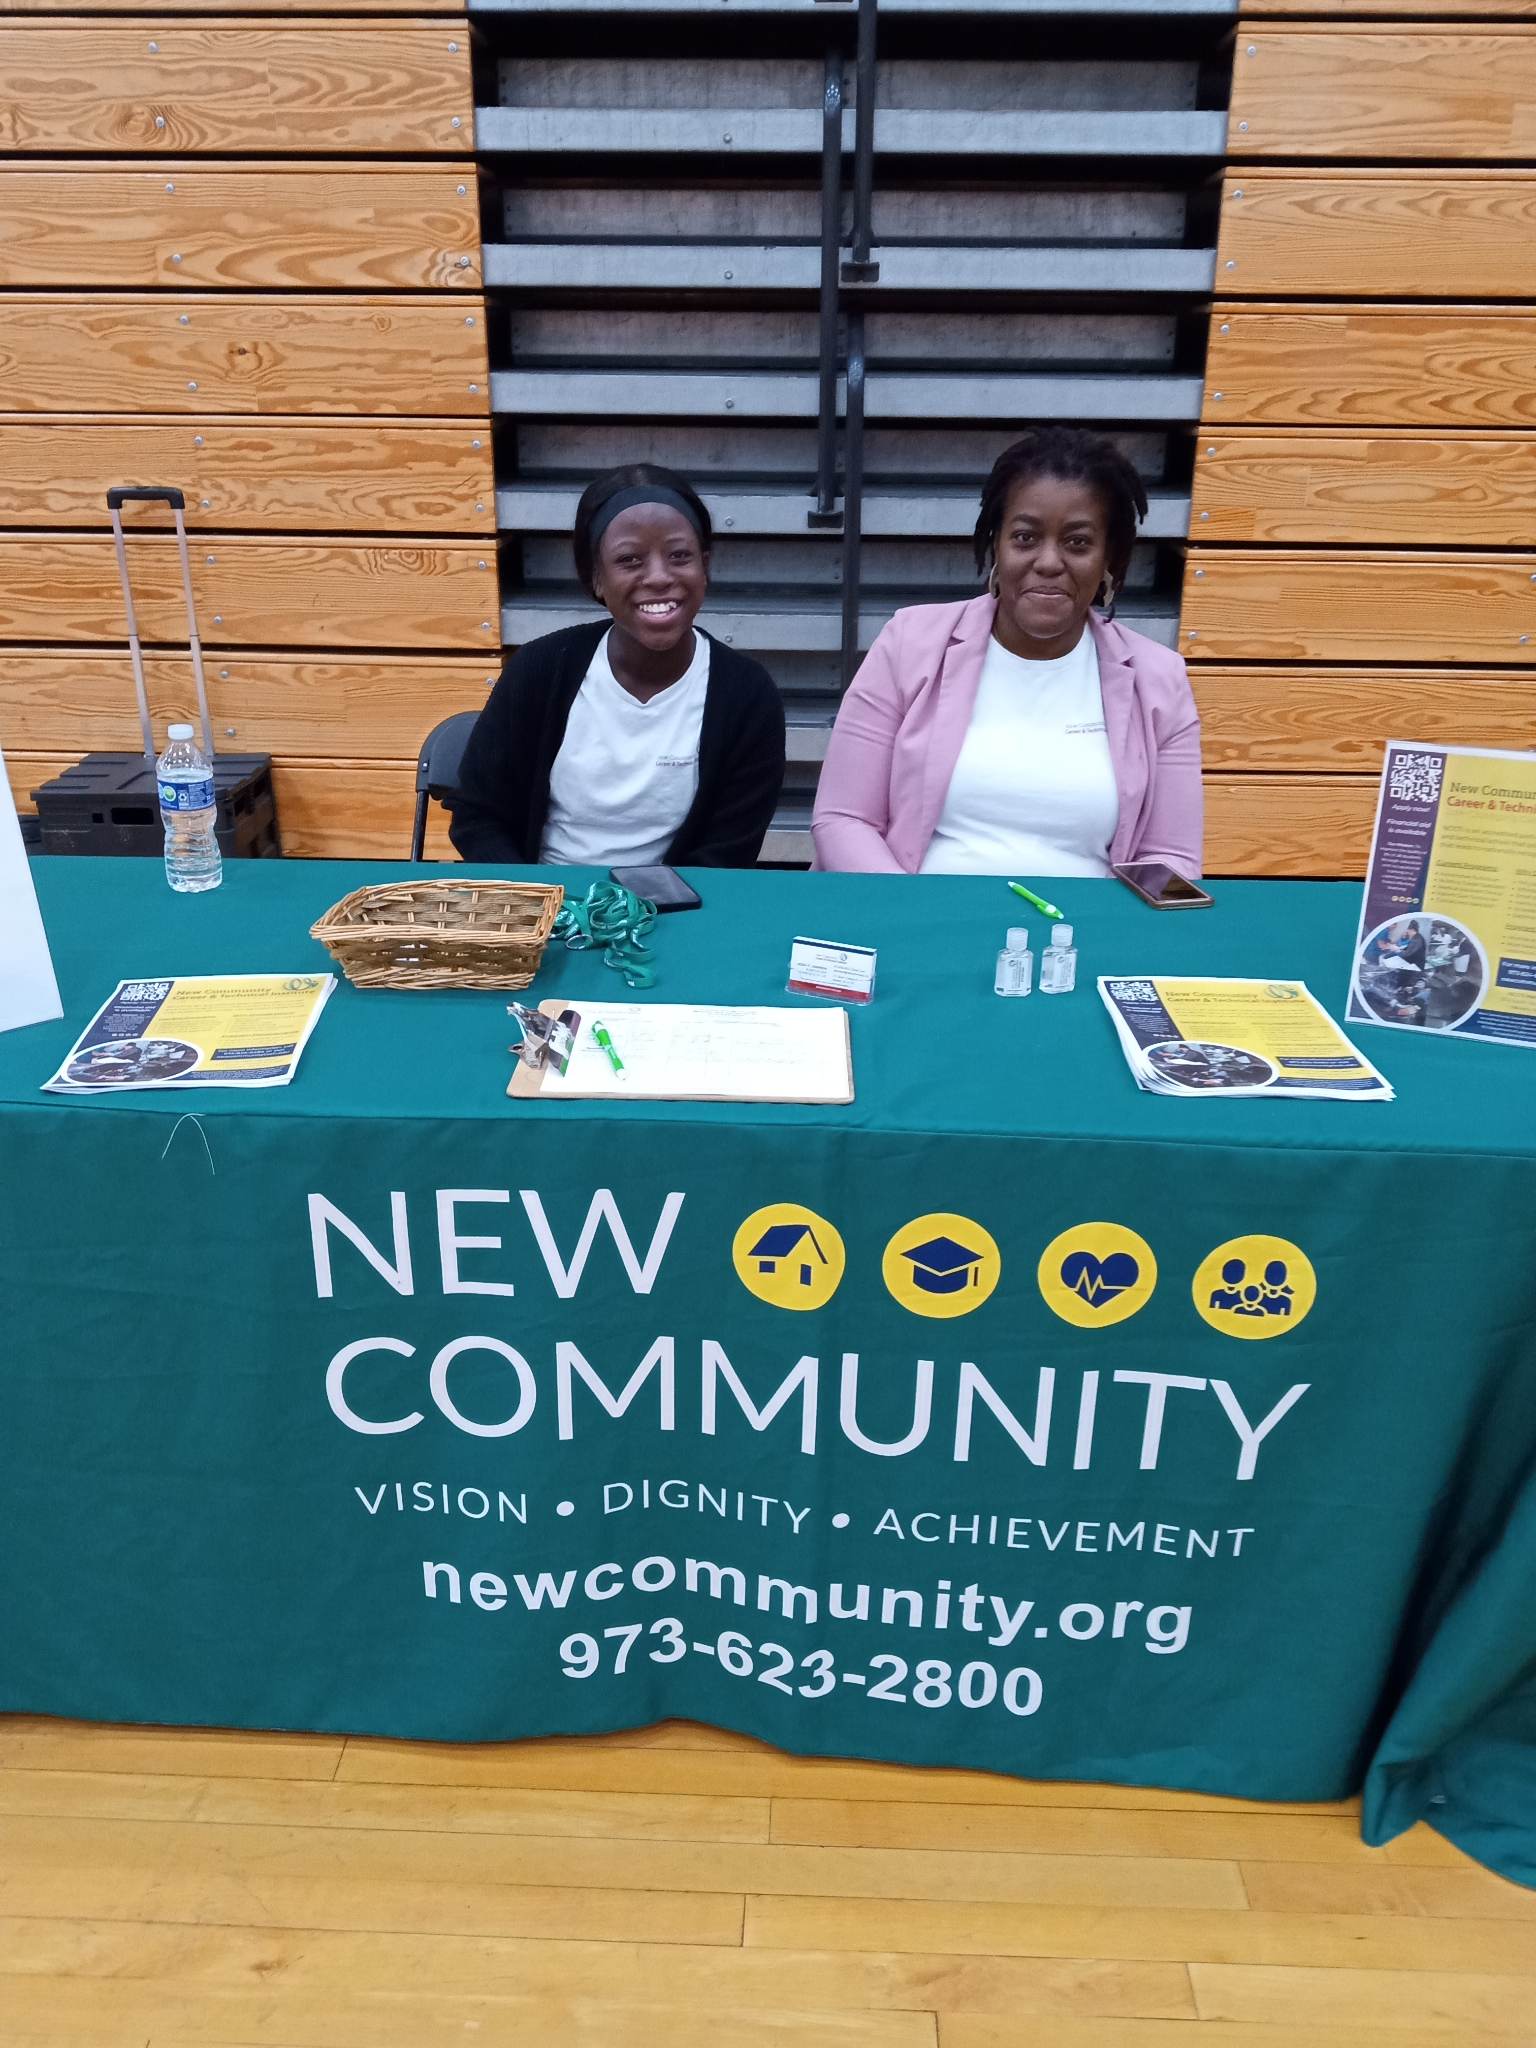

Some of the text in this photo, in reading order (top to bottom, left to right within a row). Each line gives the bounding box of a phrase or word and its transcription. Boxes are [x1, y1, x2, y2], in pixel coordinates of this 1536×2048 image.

[1447, 796, 1486, 809] Career
[1488, 800, 1497, 810] &
[1450, 782, 1479, 794] New
[307, 1188, 686, 1299] NEW
[324, 1335, 1311, 1481] COMMUNITY
[355, 1481, 1255, 1561] VISION DIGNITY ACHIEVEMENT
[423, 1555, 1193, 1656] newcommunity.org
[558, 1617, 1044, 1717] 973-623-2800
